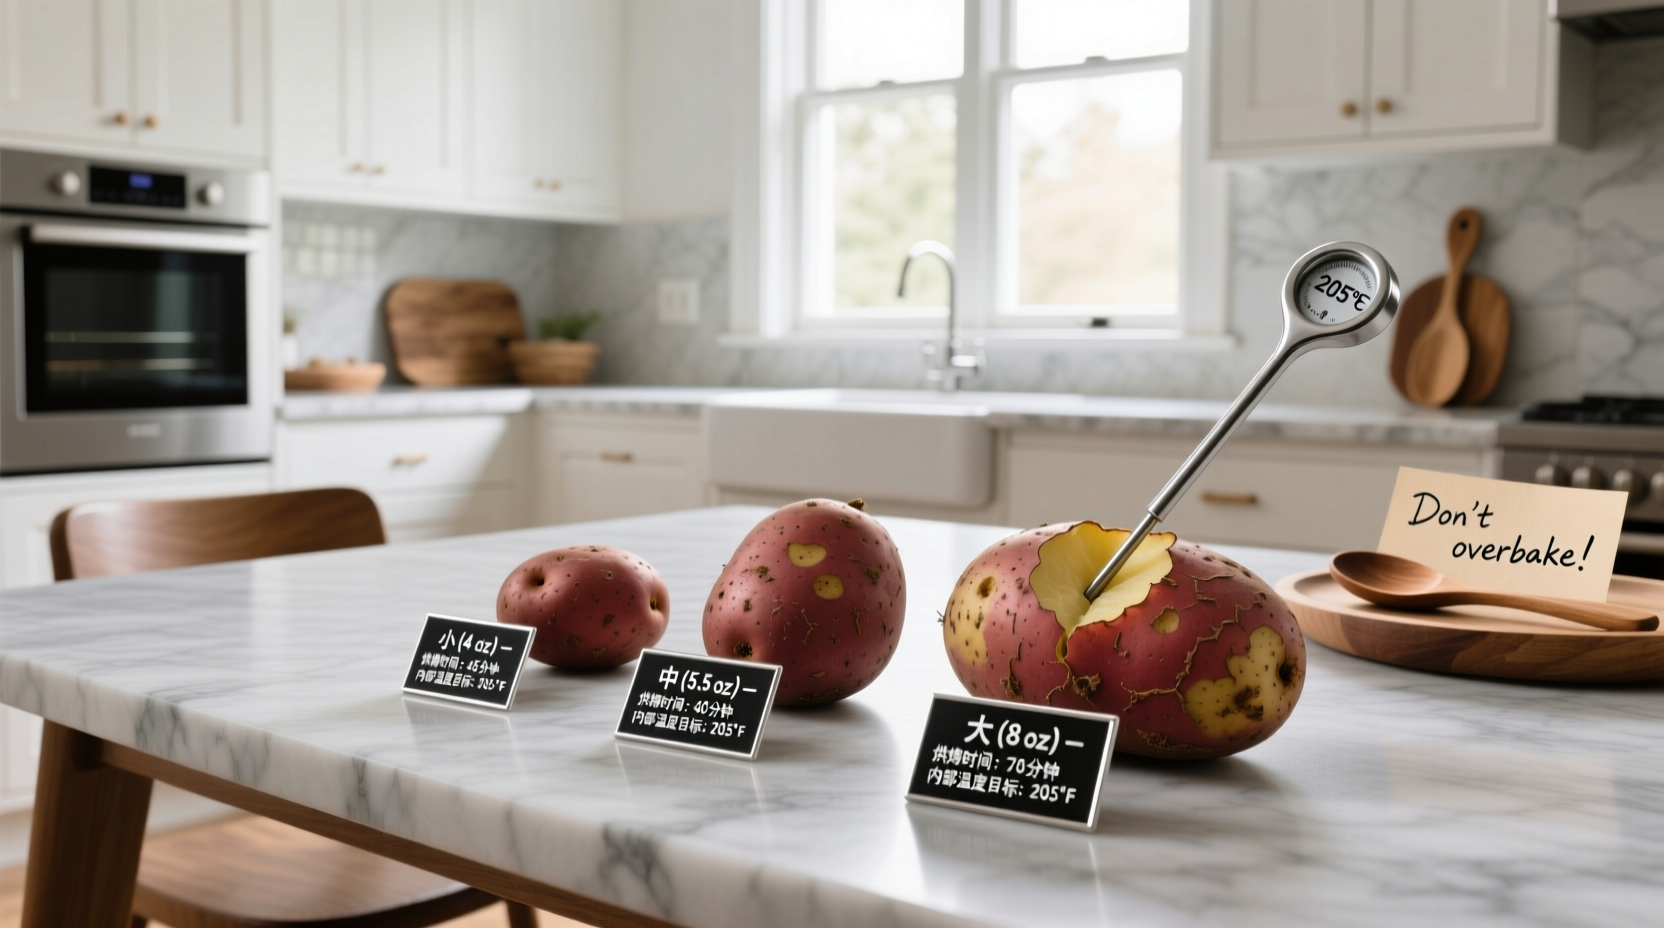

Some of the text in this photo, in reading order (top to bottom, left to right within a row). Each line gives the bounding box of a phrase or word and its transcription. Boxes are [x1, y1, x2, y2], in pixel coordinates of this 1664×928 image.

[1407, 492, 1494, 529] Don't
[1452, 534, 1595, 572] overbake!
[438, 629, 456, 650] 小
[458, 631, 474, 653] (4
[475, 635, 498, 657] oz)
[658, 664, 679, 690] 中
[680, 669, 713, 693] (5.5
[713, 675, 740, 700] oz)
[963, 714, 994, 746] 大
[997, 719, 1022, 749] (8
[1023, 726, 1060, 756] oz)
